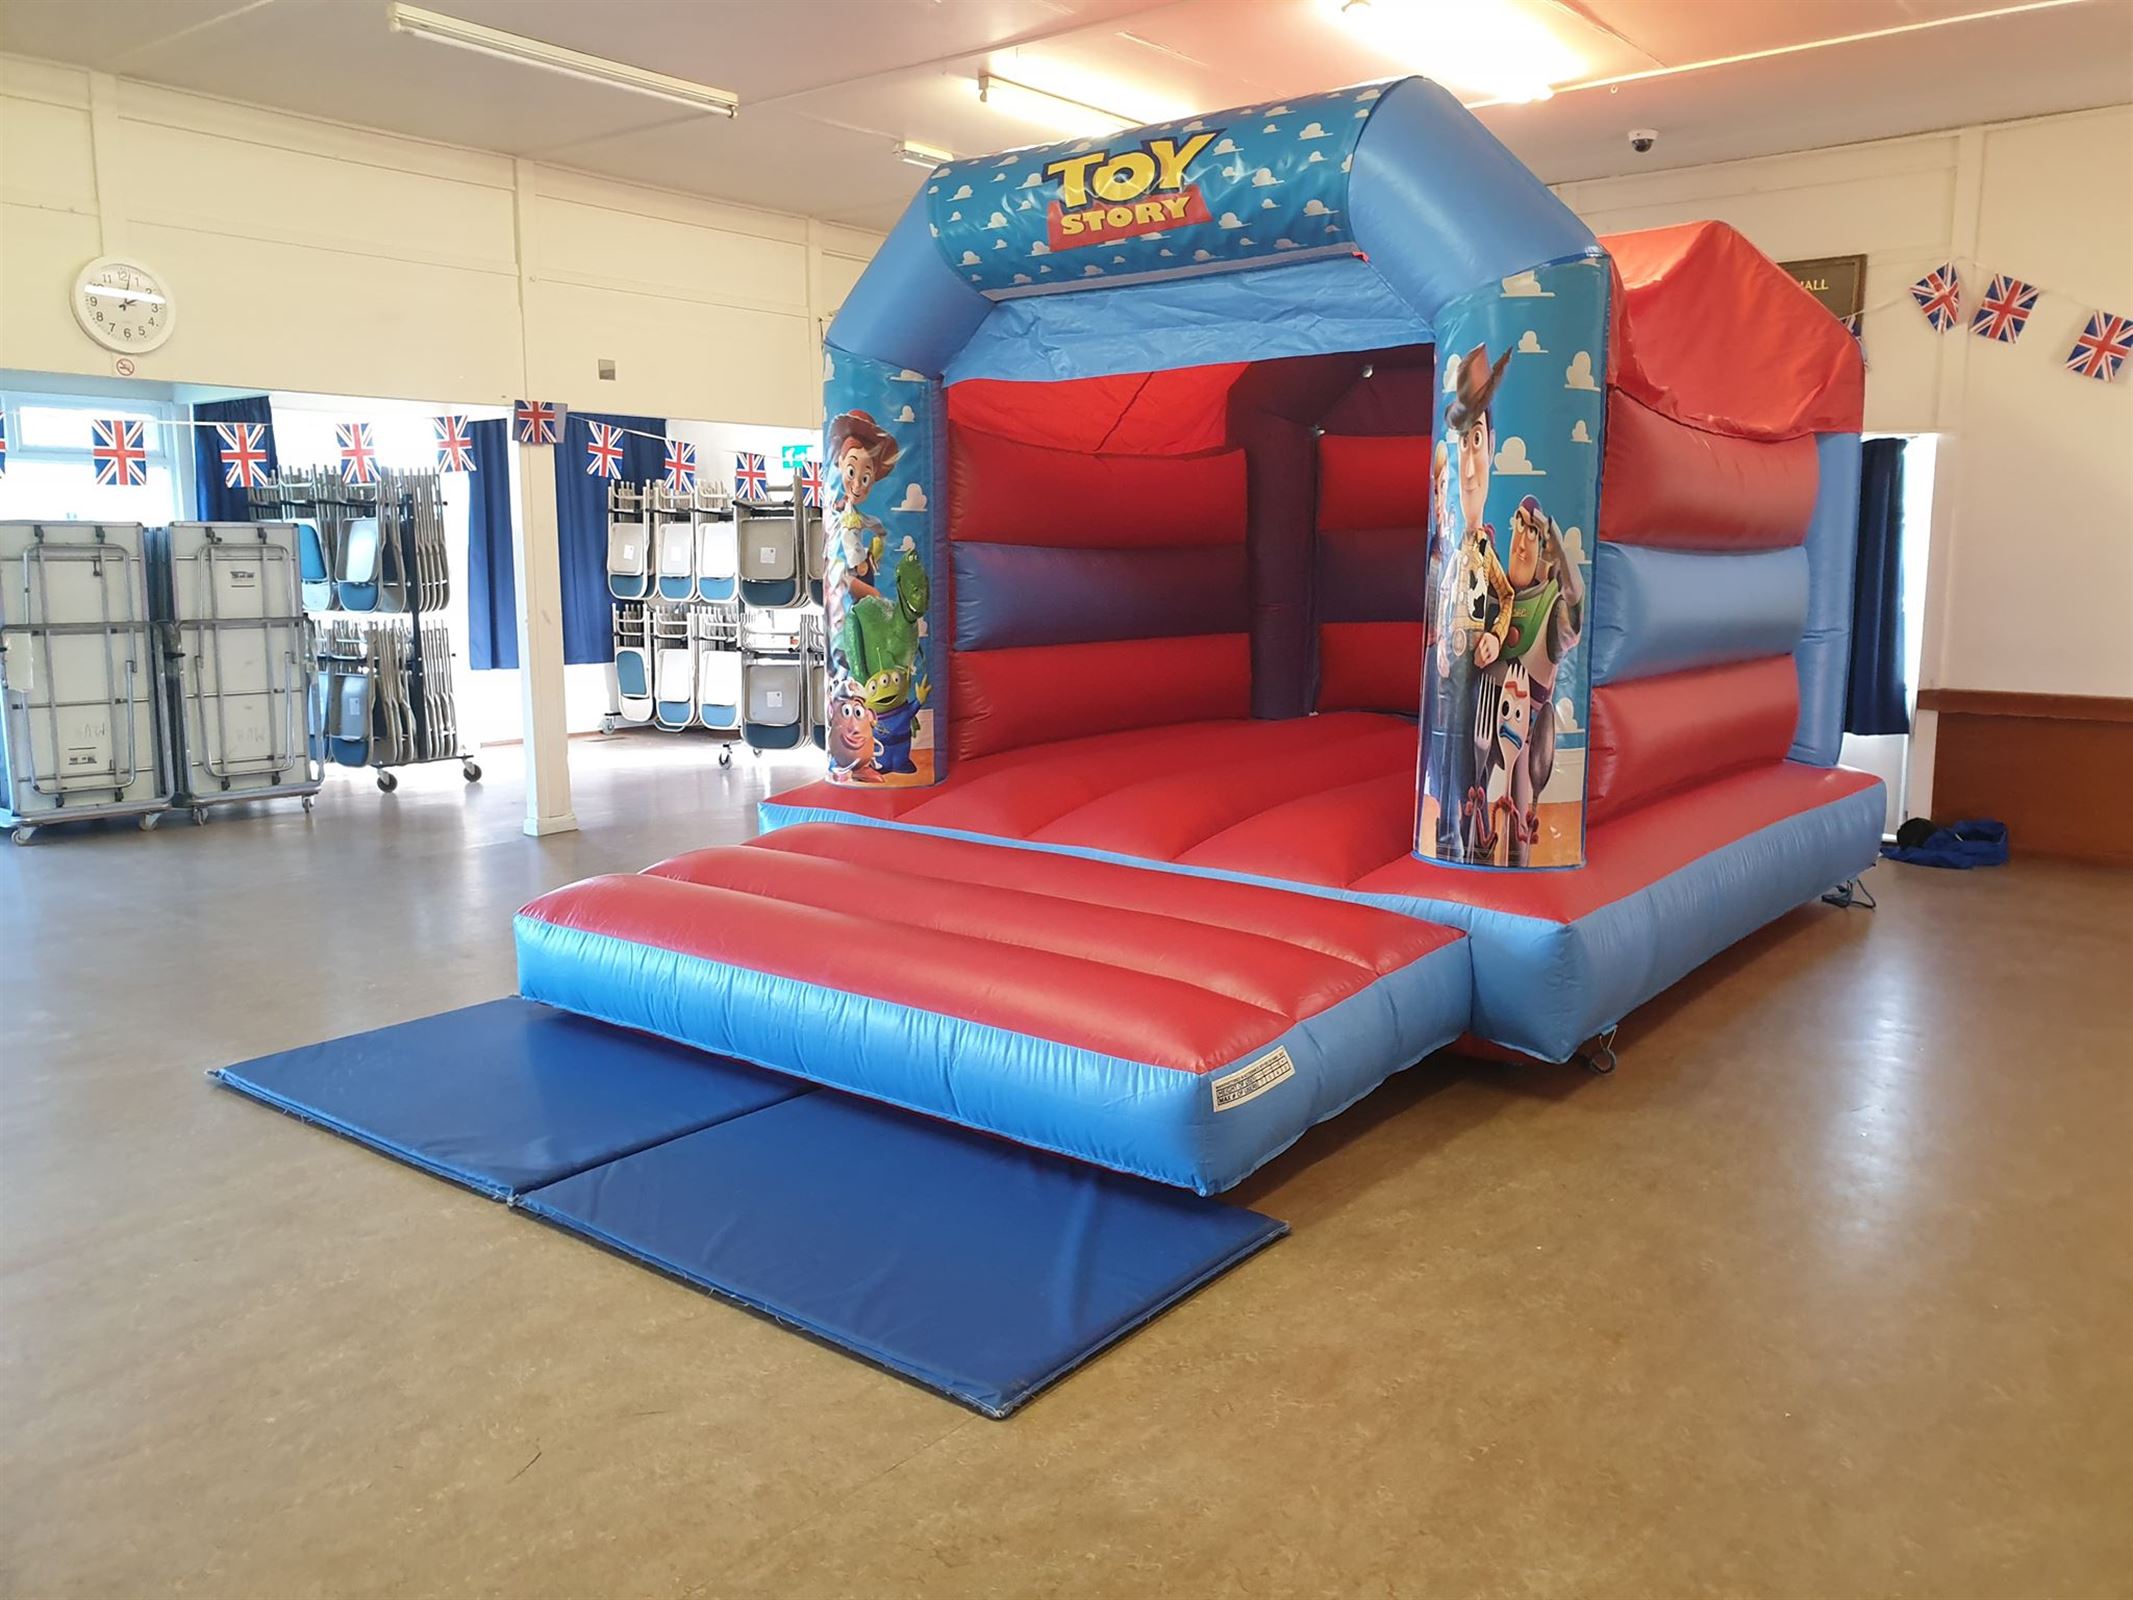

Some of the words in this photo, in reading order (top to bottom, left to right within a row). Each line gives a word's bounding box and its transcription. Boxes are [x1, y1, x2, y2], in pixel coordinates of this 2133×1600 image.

[1045, 130, 1220, 210] TOY
[1060, 196, 1191, 236] STORY
[89, 296, 98, 307] 9
[151, 302, 159, 313] 3
[95, 311, 104, 322] 8
[147, 316, 155, 327] 4
[108, 322, 116, 332] 7
[138, 325, 146, 336] 5
[123, 328, 132, 338] 6
